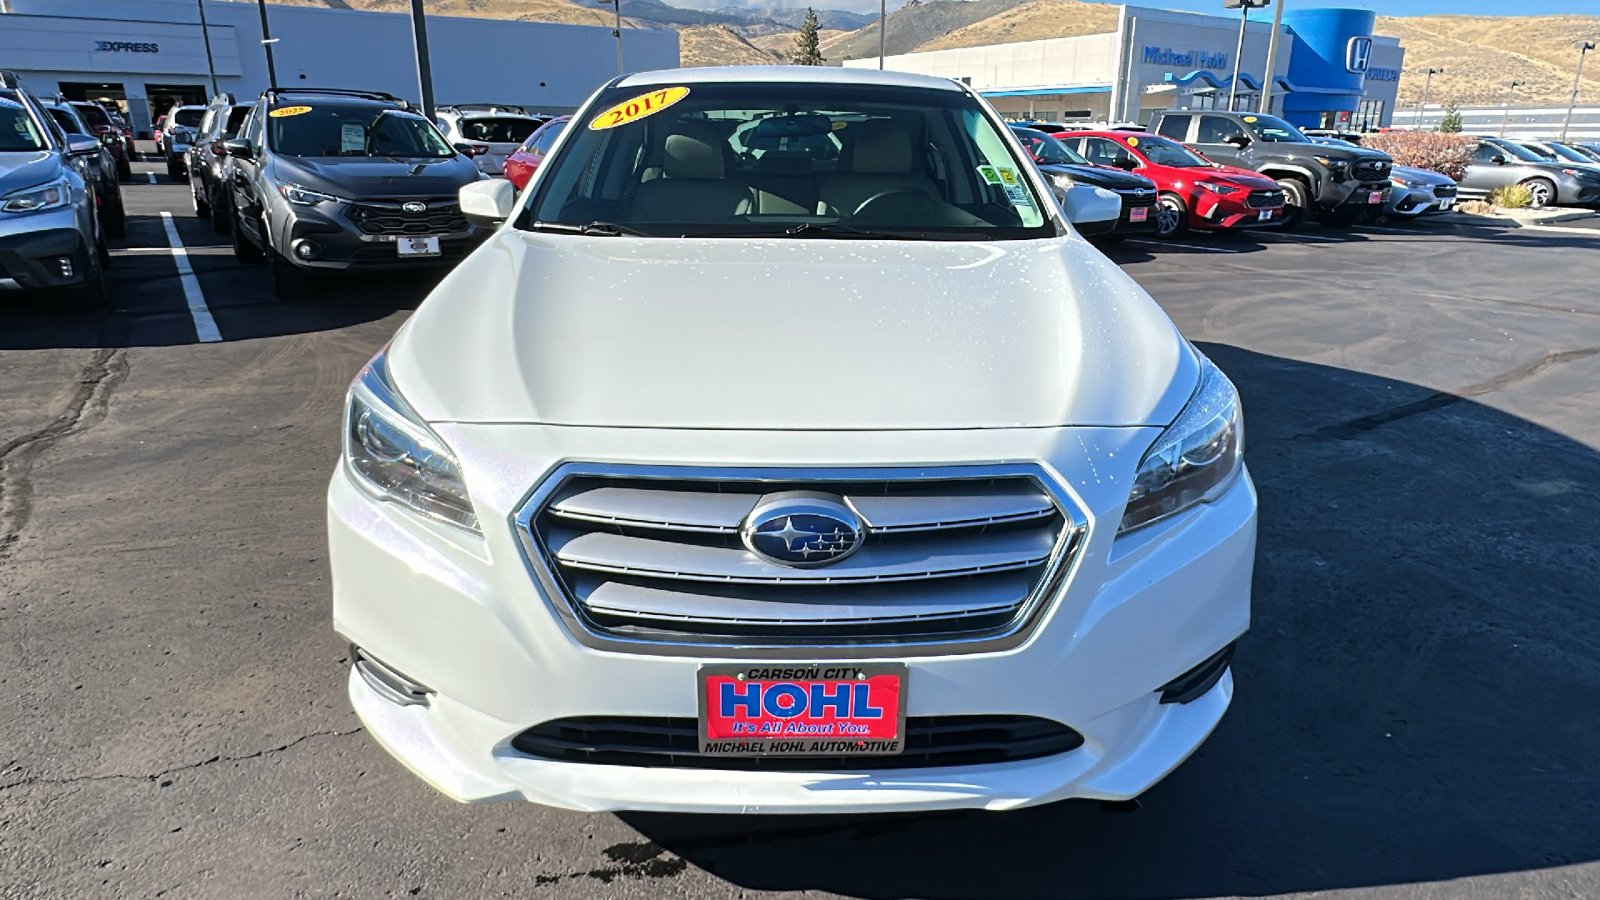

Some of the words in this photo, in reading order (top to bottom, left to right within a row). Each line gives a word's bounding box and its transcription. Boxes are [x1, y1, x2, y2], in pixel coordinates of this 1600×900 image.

[99, 41, 159, 53] EXPRESS
[1142, 46, 1195, 67] Michael
[1365, 67, 1399, 81] ONDA
[609, 91, 668, 125] 2017
[748, 667, 820, 679] CARSON
[823, 667, 861, 679] CITY
[720, 683, 883, 718] HOHL
[732, 721, 757, 735] It's
[760, 722, 783, 735] All
[785, 722, 834, 735] About
[837, 722, 871, 735] You.
[704, 742, 766, 753] MICHAEL
[769, 742, 806, 753] HOHL
[809, 740, 899, 753] AUTOMOTIVE
